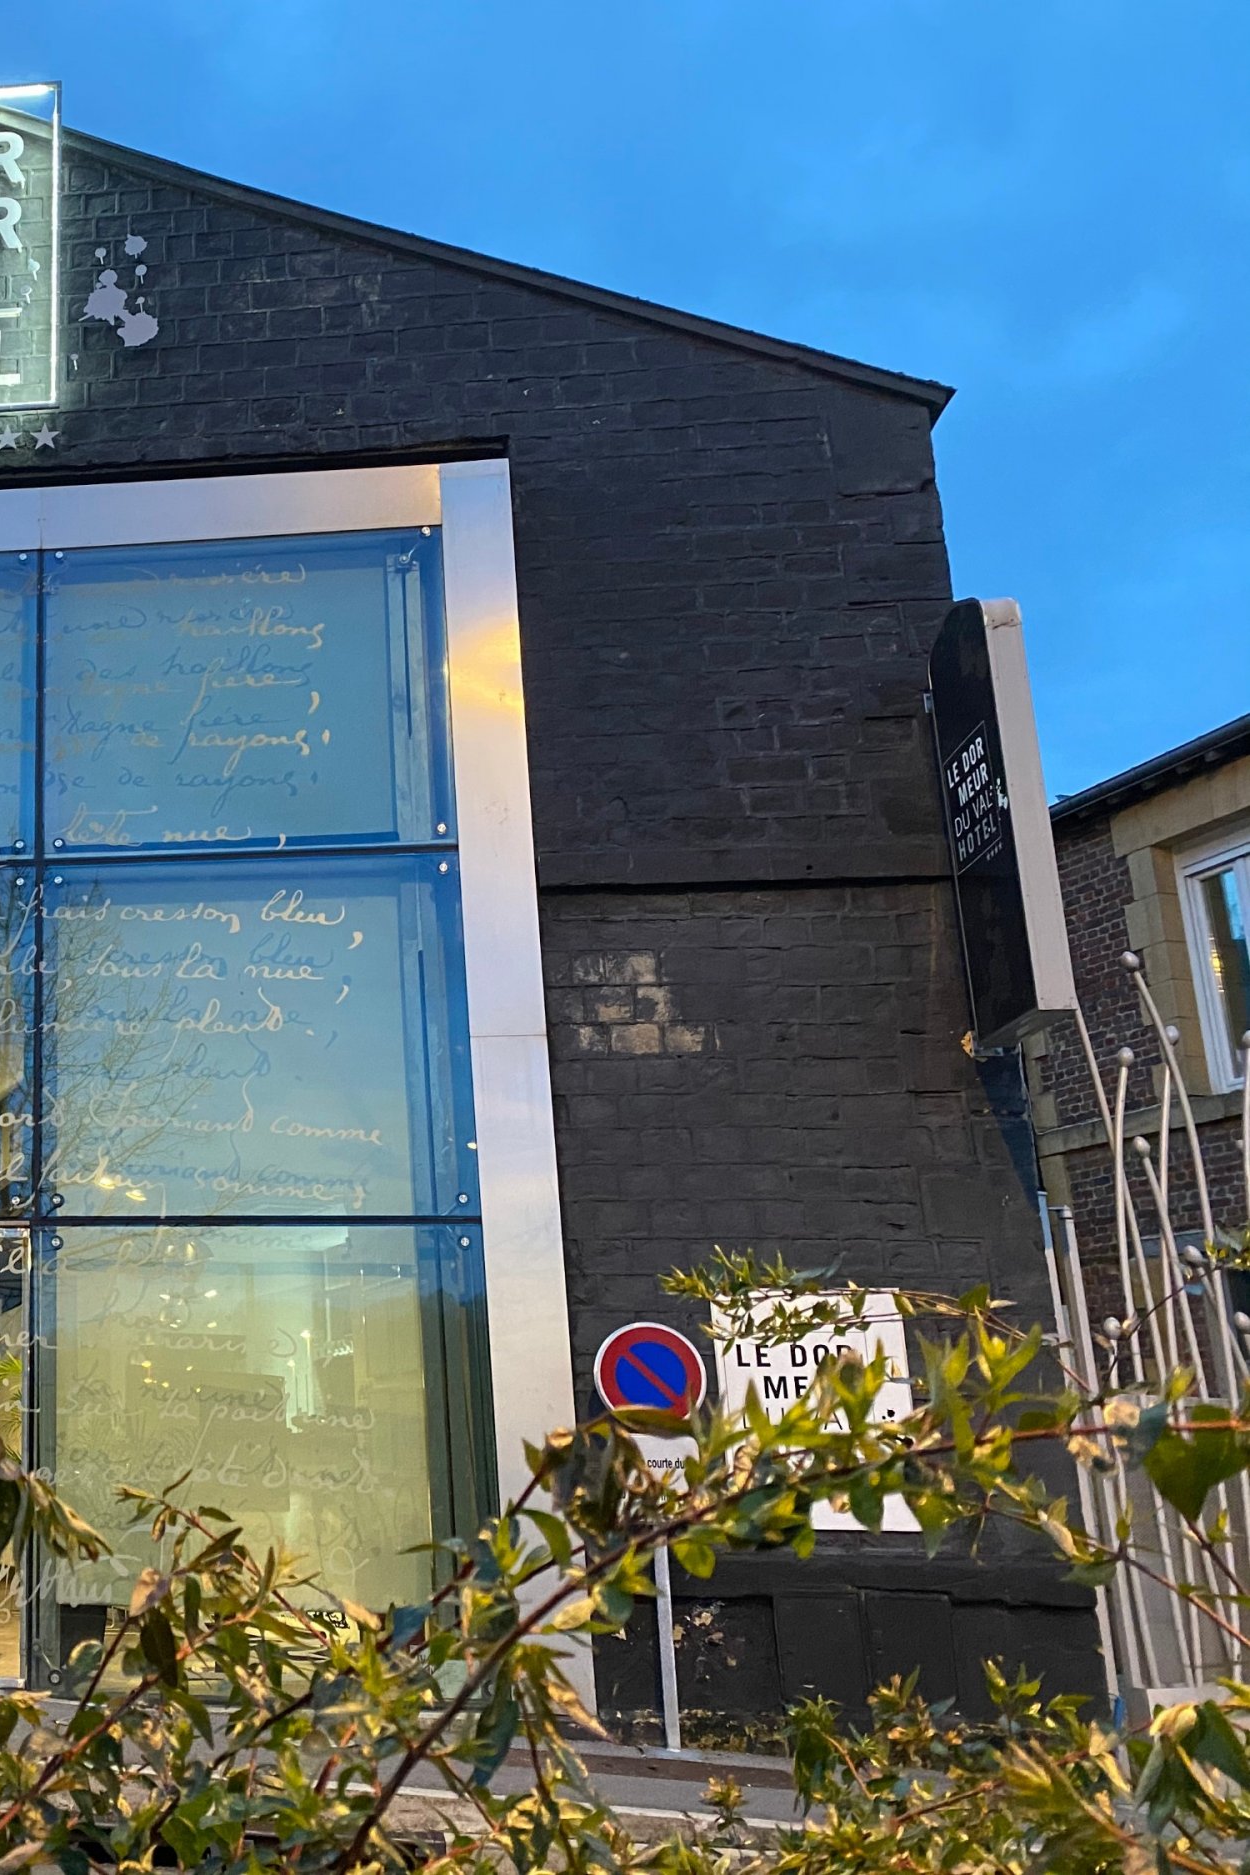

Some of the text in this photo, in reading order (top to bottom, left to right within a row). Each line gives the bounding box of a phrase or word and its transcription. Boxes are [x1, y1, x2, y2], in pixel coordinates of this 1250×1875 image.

[947, 737, 984, 789] LE DOR
[958, 763, 989, 807] MEUR
[954, 789, 993, 838] DU VAL
[958, 813, 996, 861] HOTEL
[736, 1344, 771, 1367] LE
[763, 1376, 808, 1399] ME
[647, 1458, 673, 1469] courte
